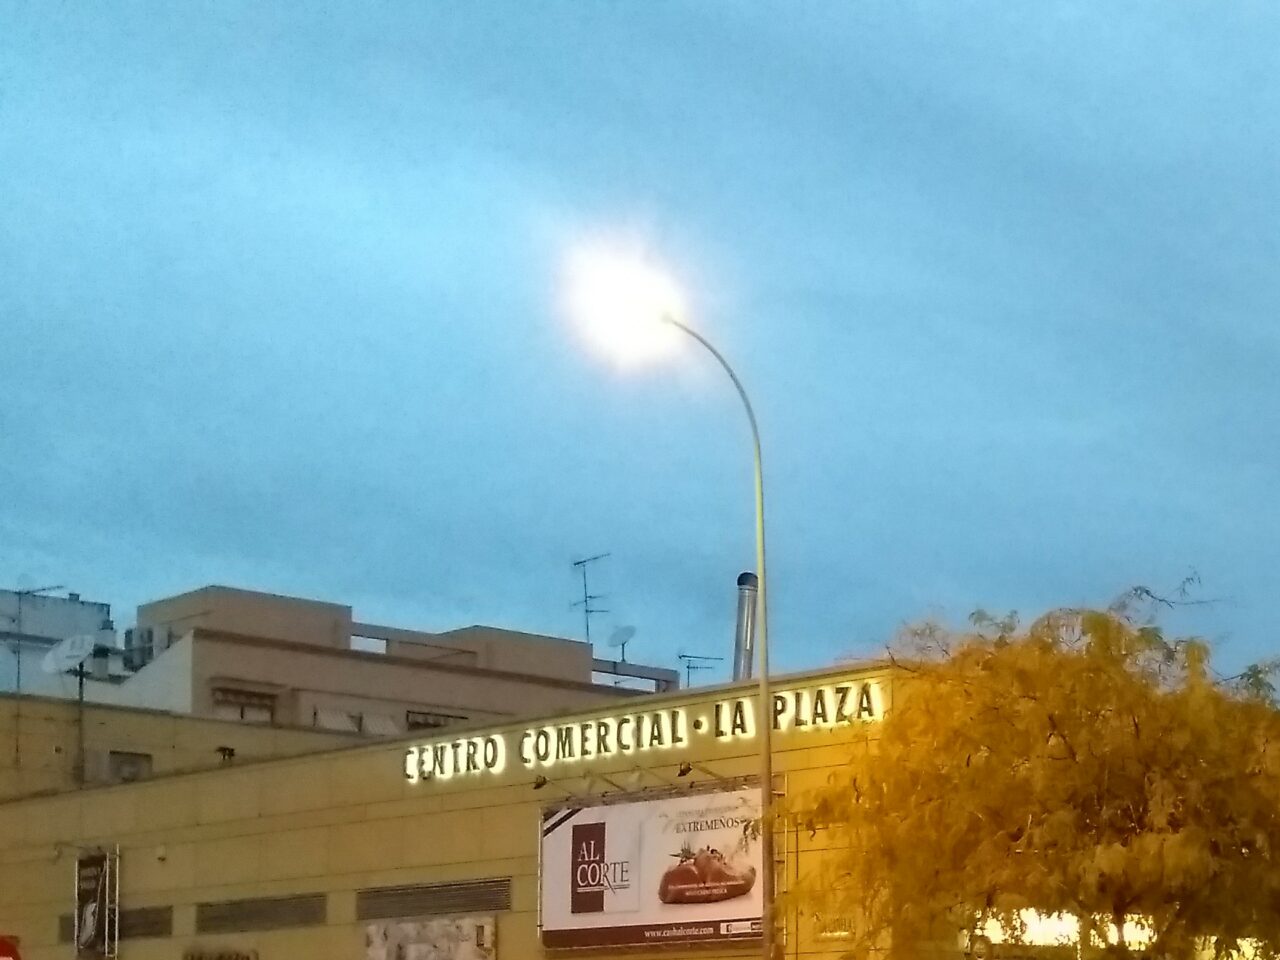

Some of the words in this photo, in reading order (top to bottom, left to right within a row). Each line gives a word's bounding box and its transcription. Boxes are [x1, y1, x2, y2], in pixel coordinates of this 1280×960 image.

[404, 737, 499, 780] CENTRO
[518, 709, 684, 764] COMERCIAL
[714, 700, 748, 738] LA
[772, 682, 875, 730] PLAZA
[674, 815, 740, 834] EXTREMEÑOS
[577, 839, 600, 863] AL
[576, 860, 630, 894] CORTE
